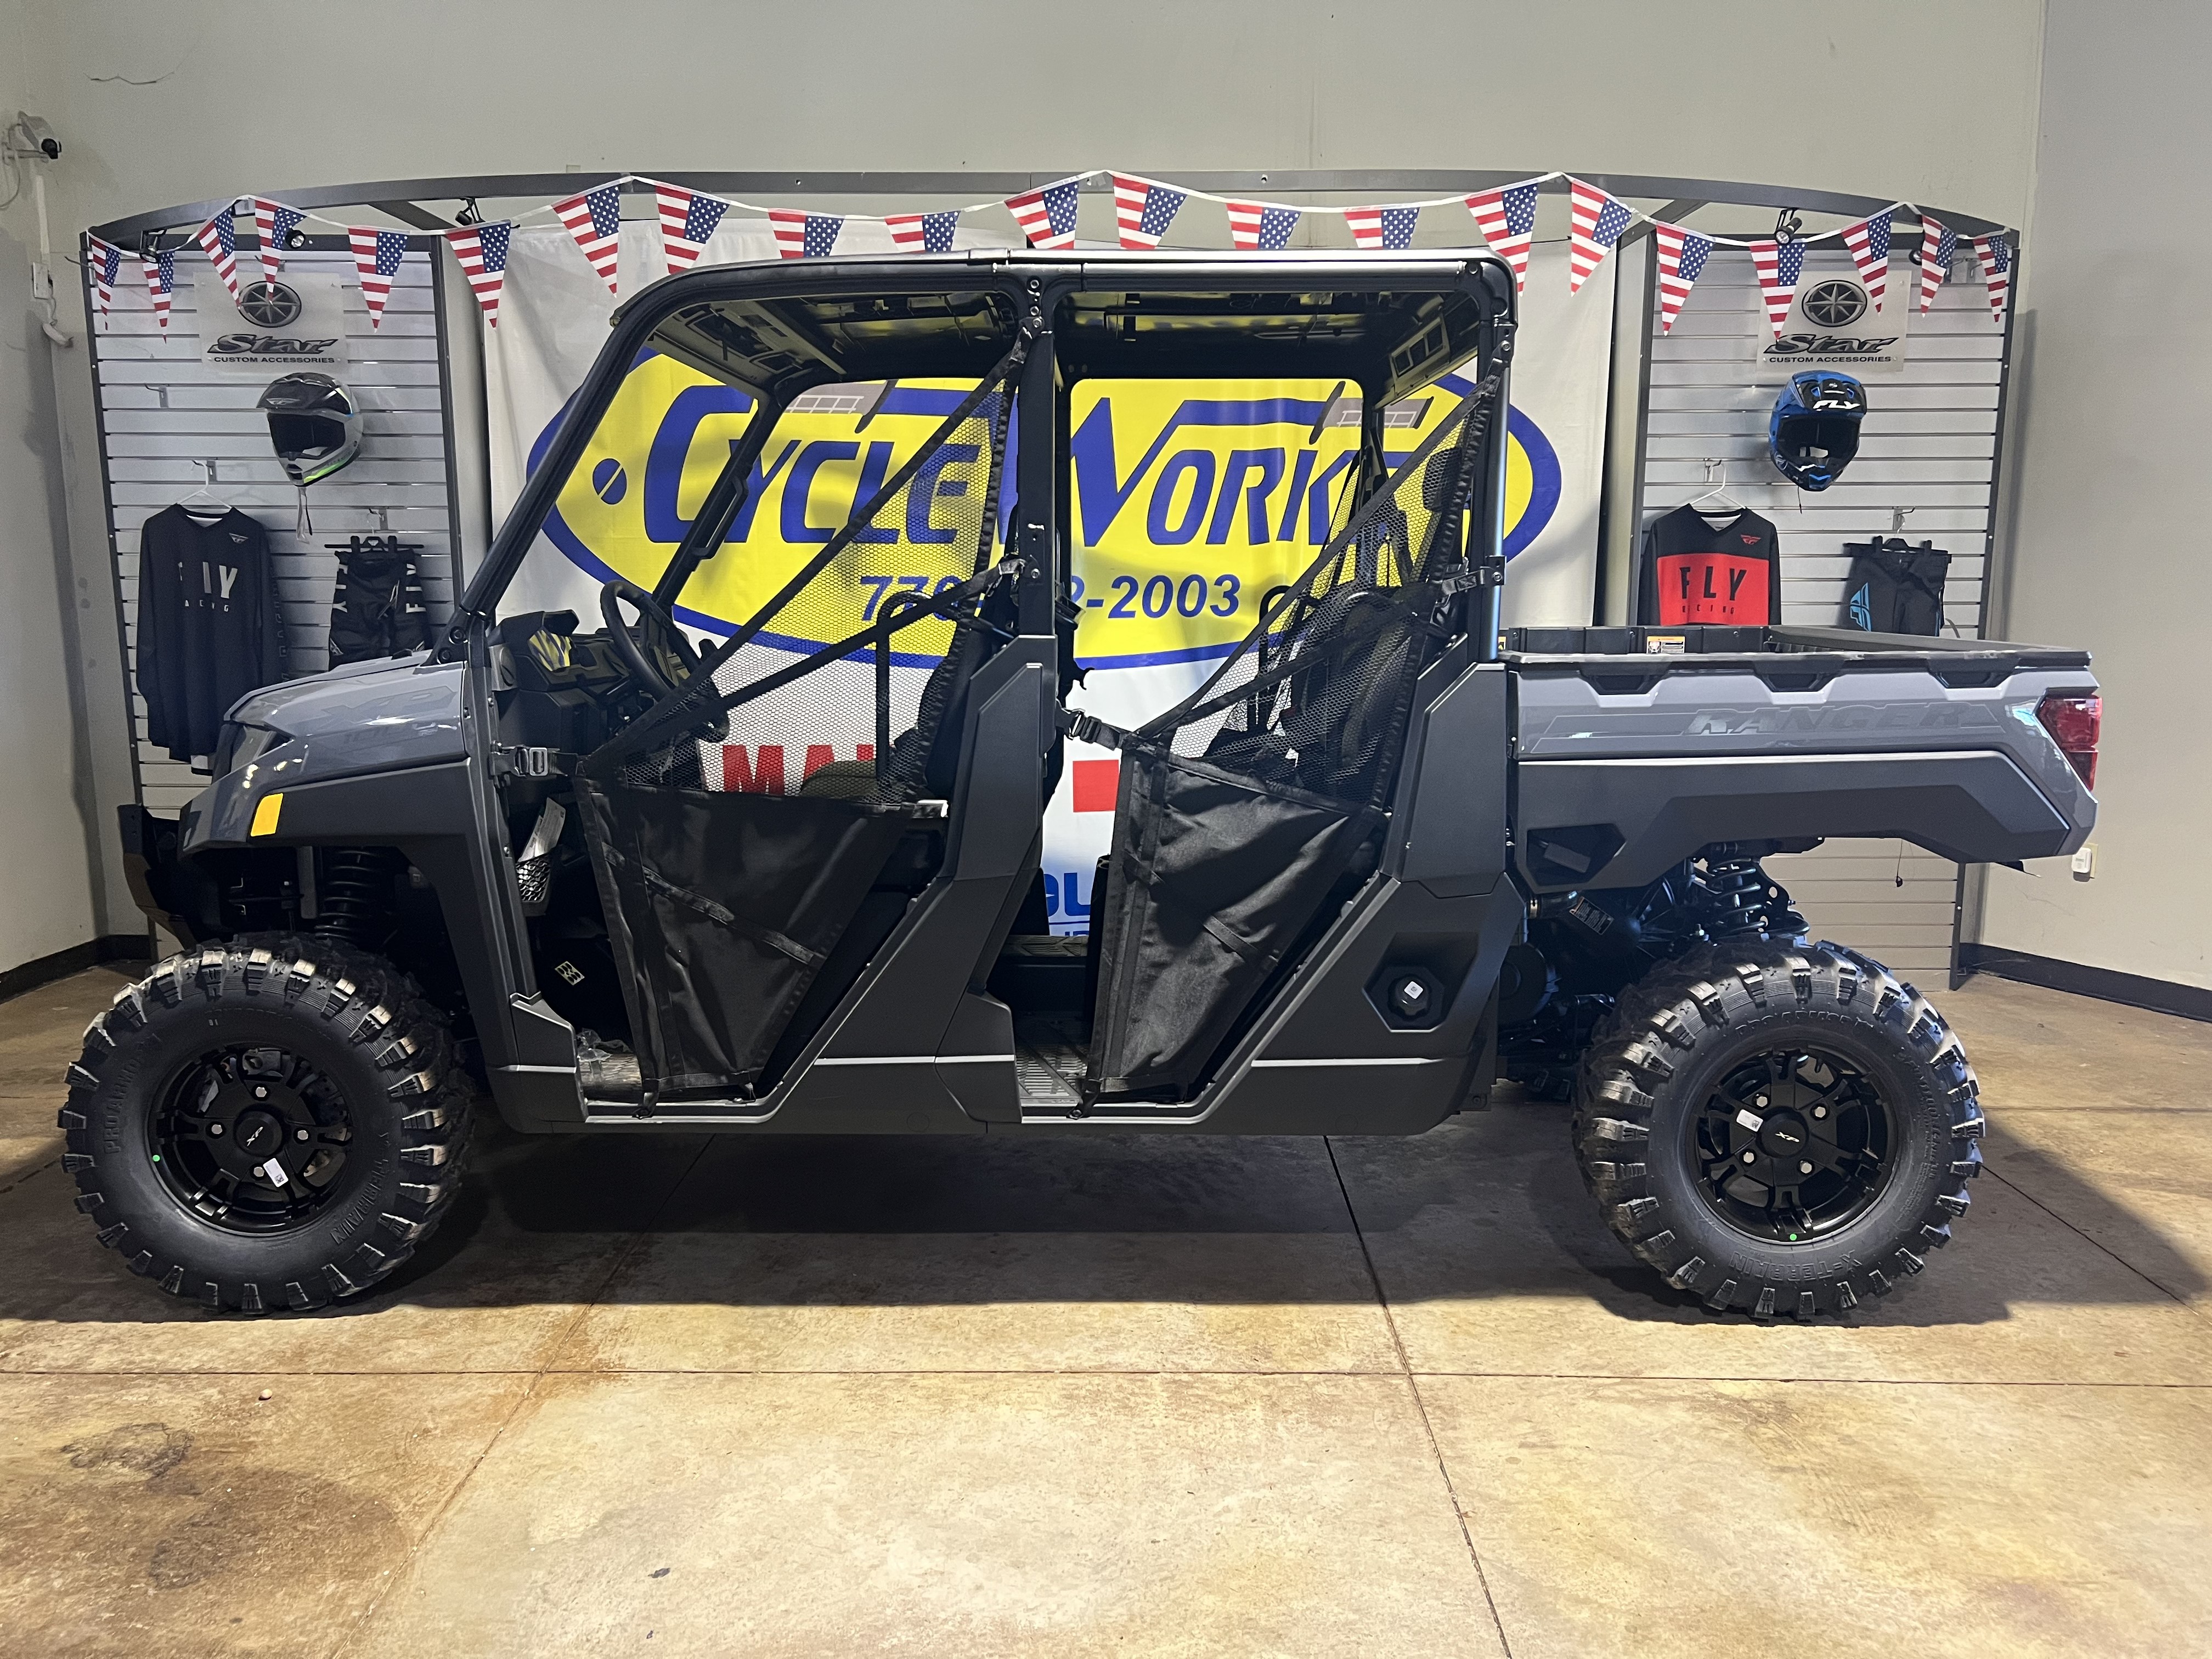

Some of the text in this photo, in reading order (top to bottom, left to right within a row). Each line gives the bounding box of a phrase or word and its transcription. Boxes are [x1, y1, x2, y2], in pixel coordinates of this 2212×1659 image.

[207, 334, 338, 354] Star
[1763, 334, 1899, 354] Star
[1813, 399, 1861, 410] FLY
[644, 385, 1470, 548] CYCLE WORK
[1679, 566, 1747, 601] FLY
[1685, 703, 1968, 734] RANGER
[246, 1126, 263, 1147] XP
[1775, 1131, 1800, 1143] XP
